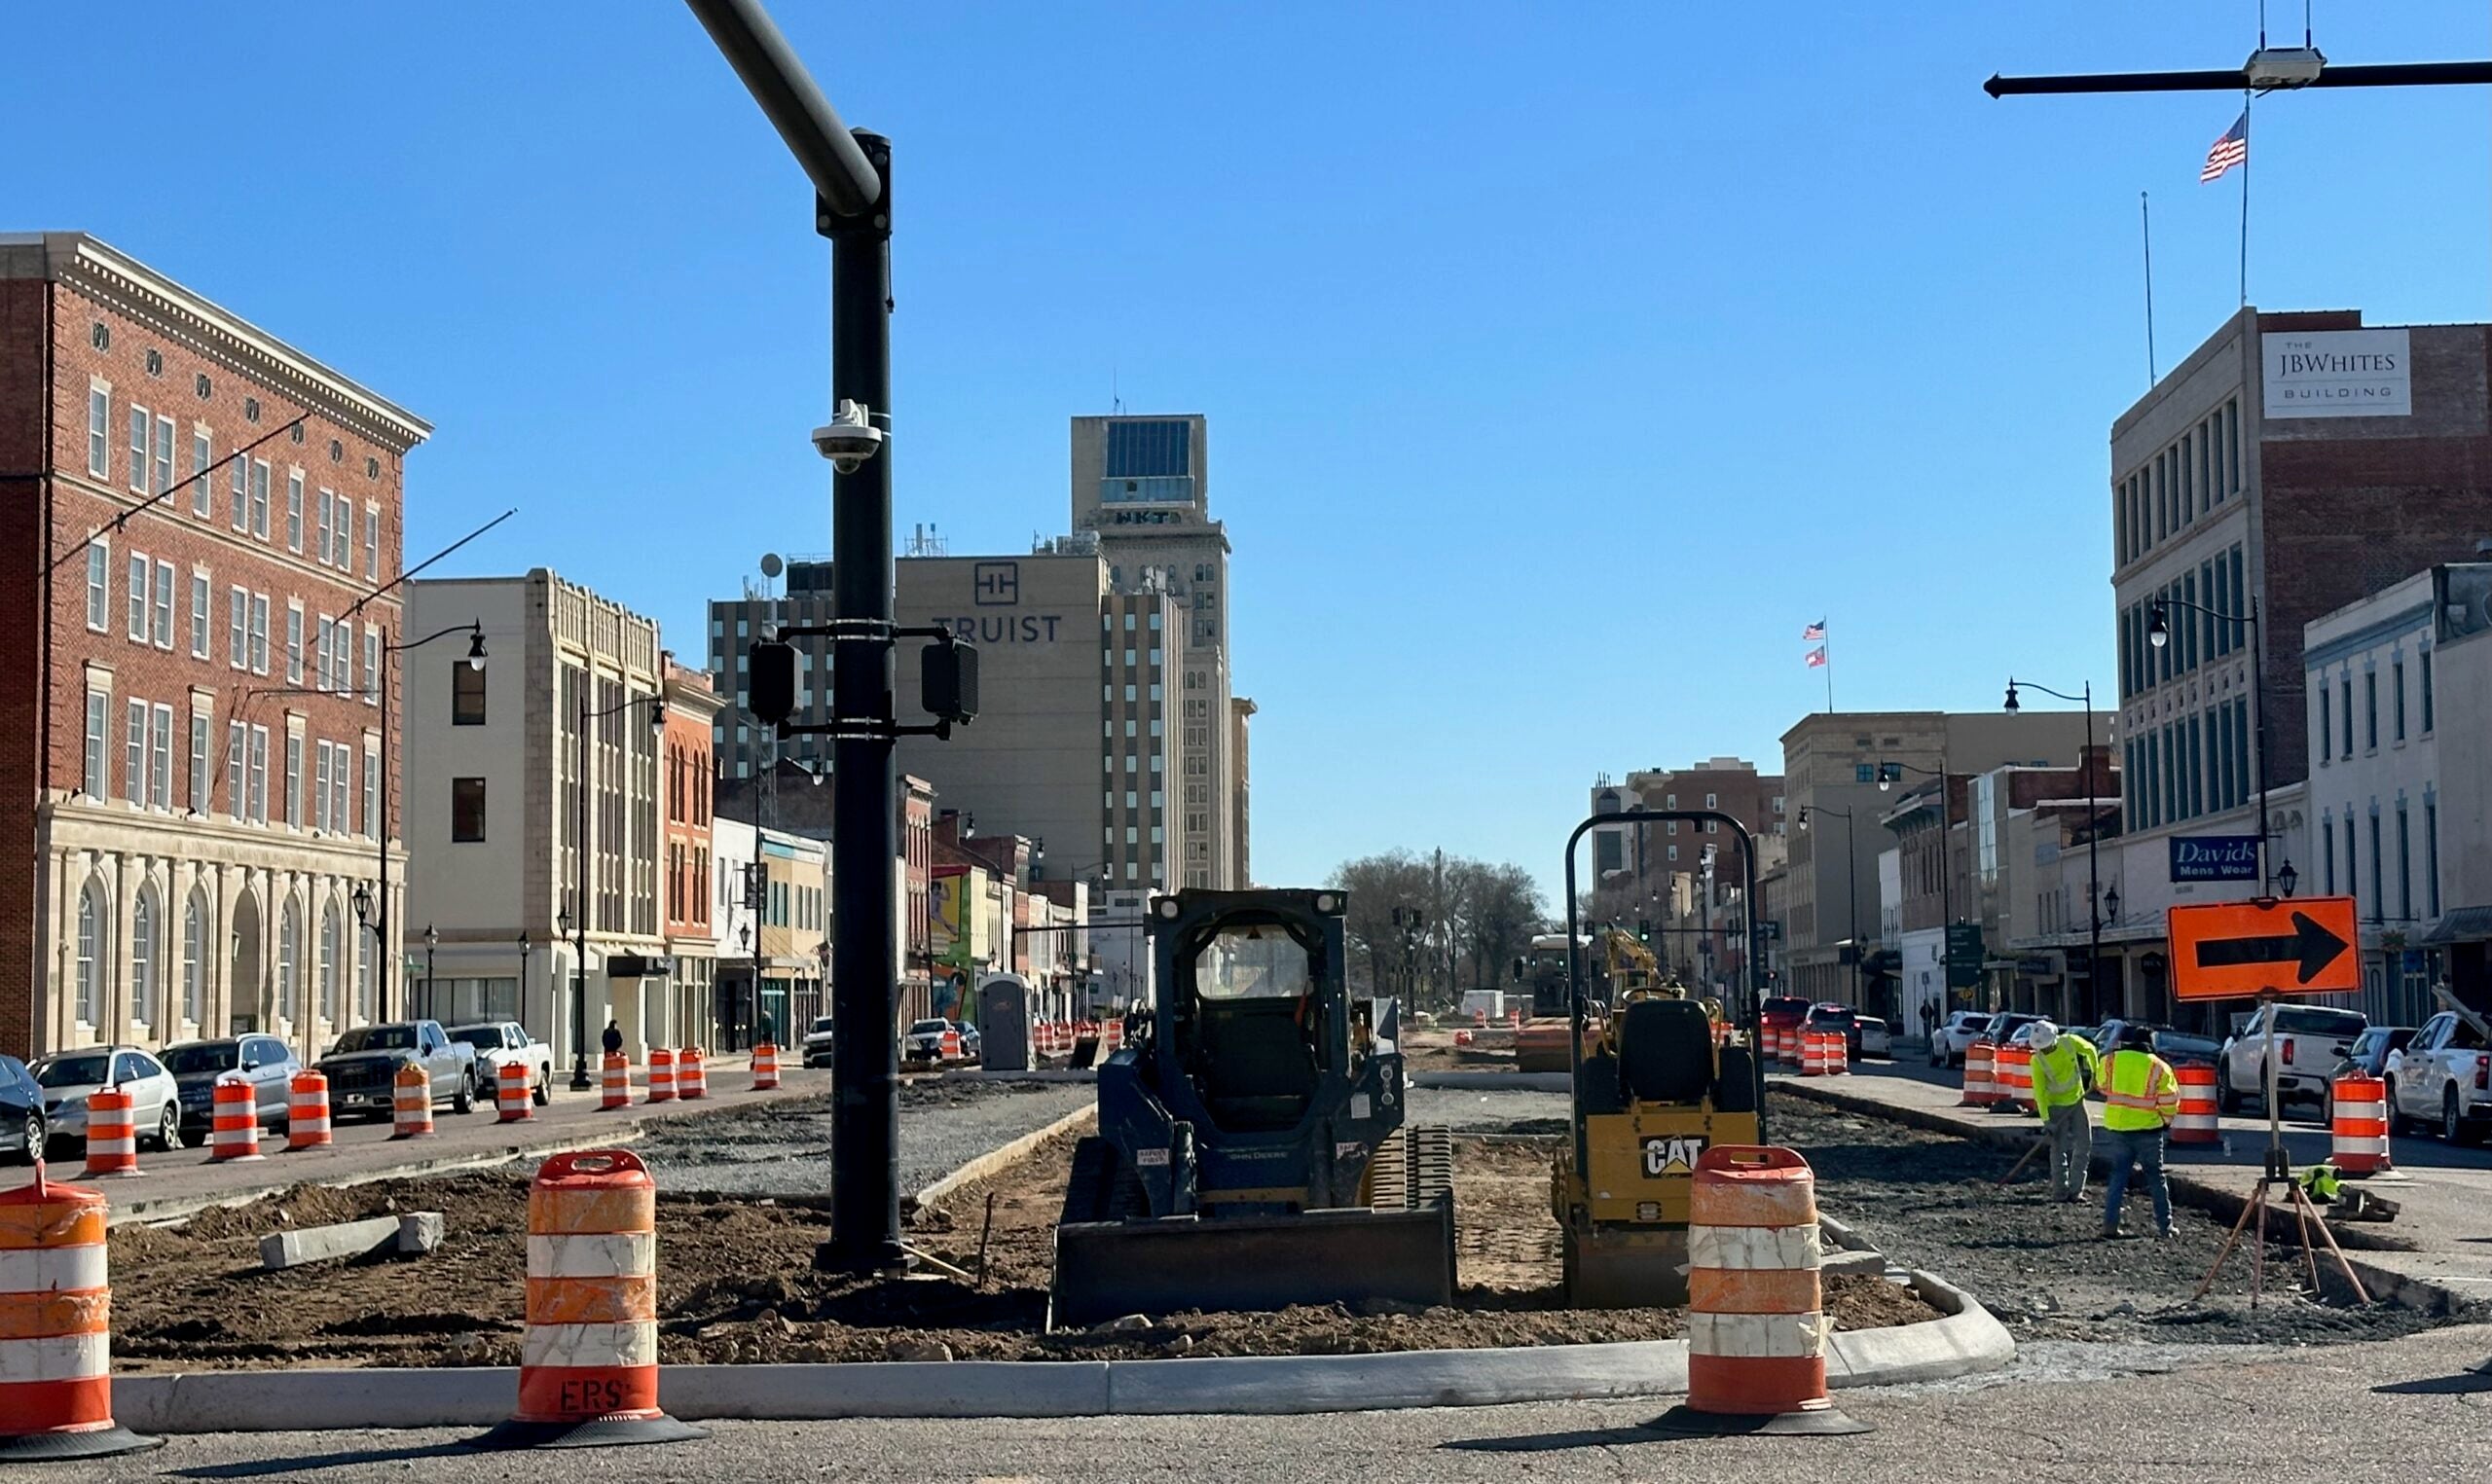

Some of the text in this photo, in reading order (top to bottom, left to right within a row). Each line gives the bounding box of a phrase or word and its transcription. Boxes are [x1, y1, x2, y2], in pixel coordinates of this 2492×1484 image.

[2285, 387, 2392, 399] BUILDING
[932, 615, 1062, 642] TRUIST
[2177, 842, 2255, 863] Davids
[2180, 865, 2253, 876] Mens Wear
[1646, 1139, 1703, 1175] CAT
[561, 1379, 622, 1411] ERS
